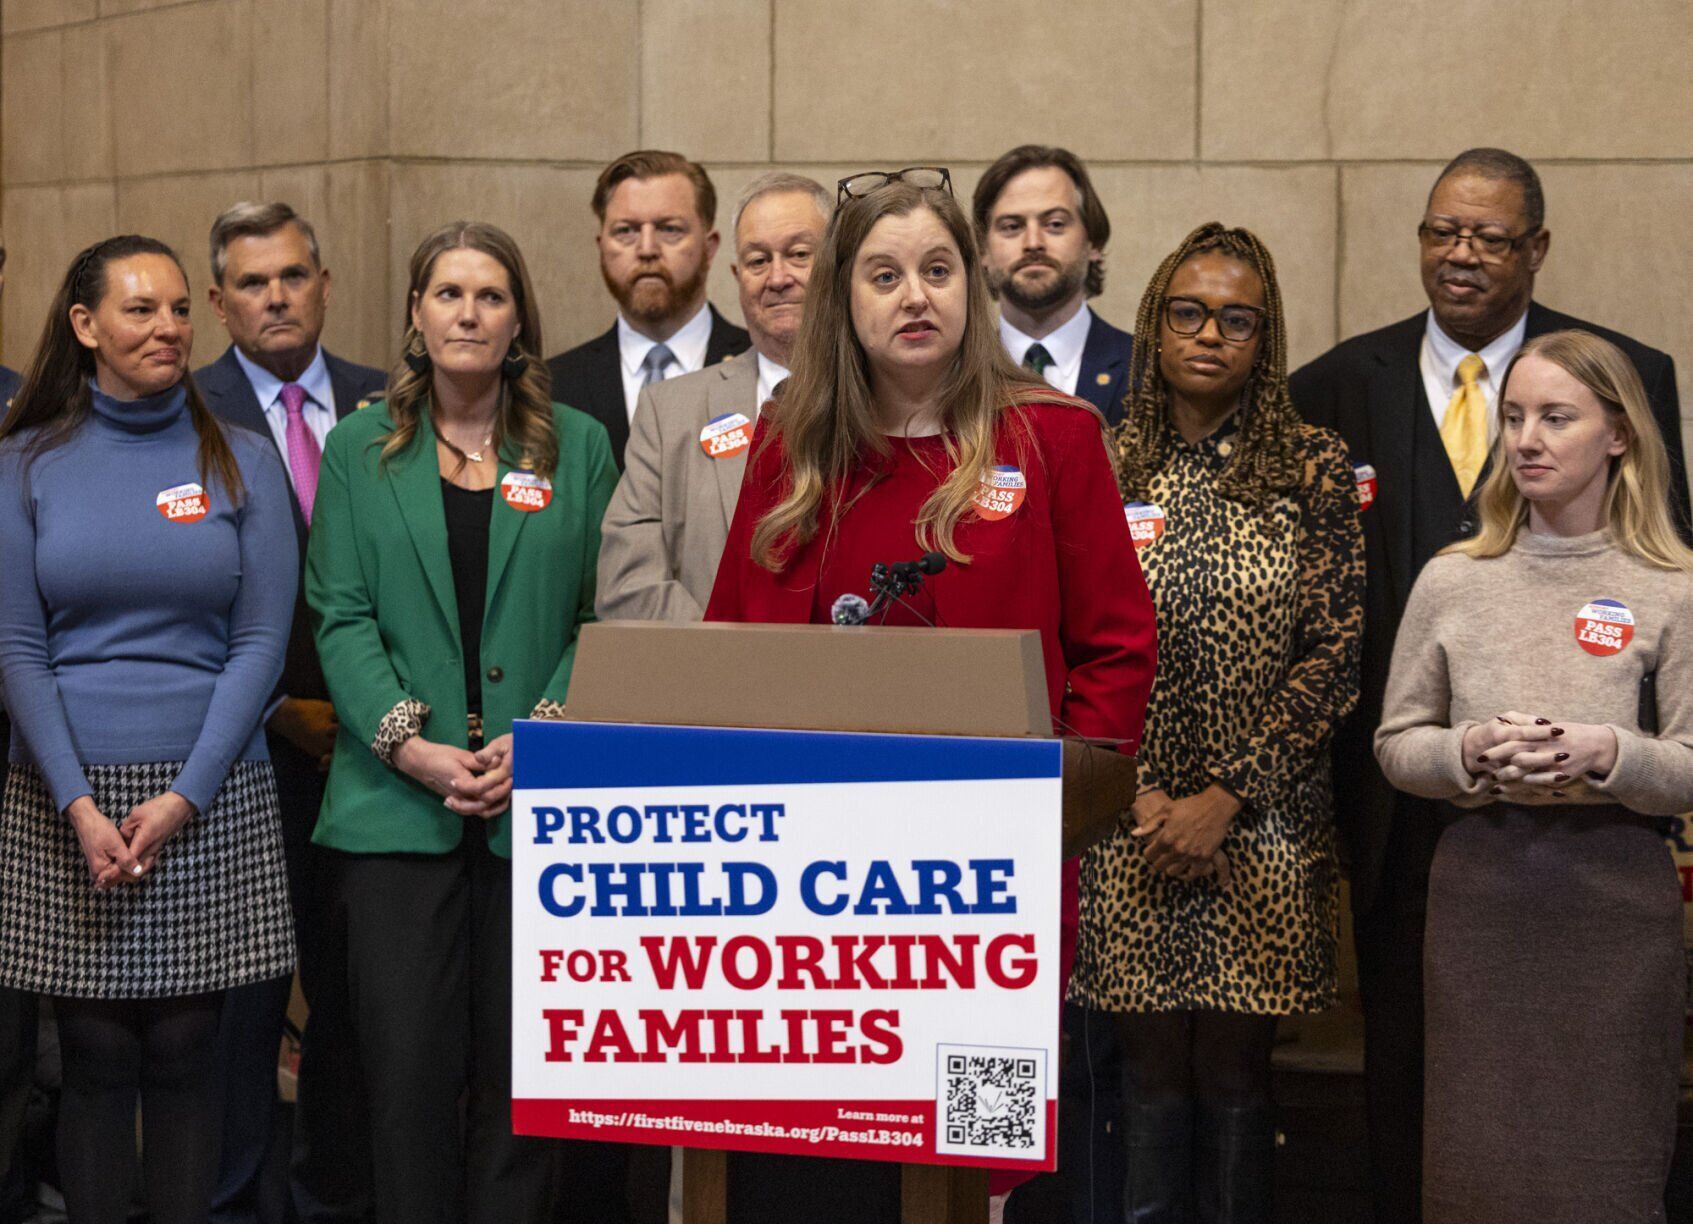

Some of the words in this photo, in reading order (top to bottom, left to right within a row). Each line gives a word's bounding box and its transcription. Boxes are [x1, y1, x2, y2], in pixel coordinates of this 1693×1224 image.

[710, 436, 748, 454] LB304
[711, 429, 744, 446] PASS
[506, 491, 544, 508] LB304
[510, 484, 542, 499] PASS
[980, 484, 1015, 503] PASS
[166, 505, 206, 518] LB304
[168, 498, 200, 510] PASS
[1128, 521, 1154, 532] ASS
[1131, 530, 1155, 540] 304
[1585, 620, 1623, 638] PASS
[1578, 630, 1622, 649] LB304
[531, 804, 785, 845] PROTECT
[538, 861, 779, 918] CHILD
[800, 858, 1018, 917] CARE
[539, 949, 632, 983] FOR
[640, 933, 1039, 991] WORKING
[542, 1008, 904, 1065] FAMILIES
[837, 1107, 875, 1121] Learn
[876, 1112, 910, 1123] more
[911, 1113, 925, 1124] at
[568, 1108, 925, 1148] https://firstfivenebraska.org/PassLB304
